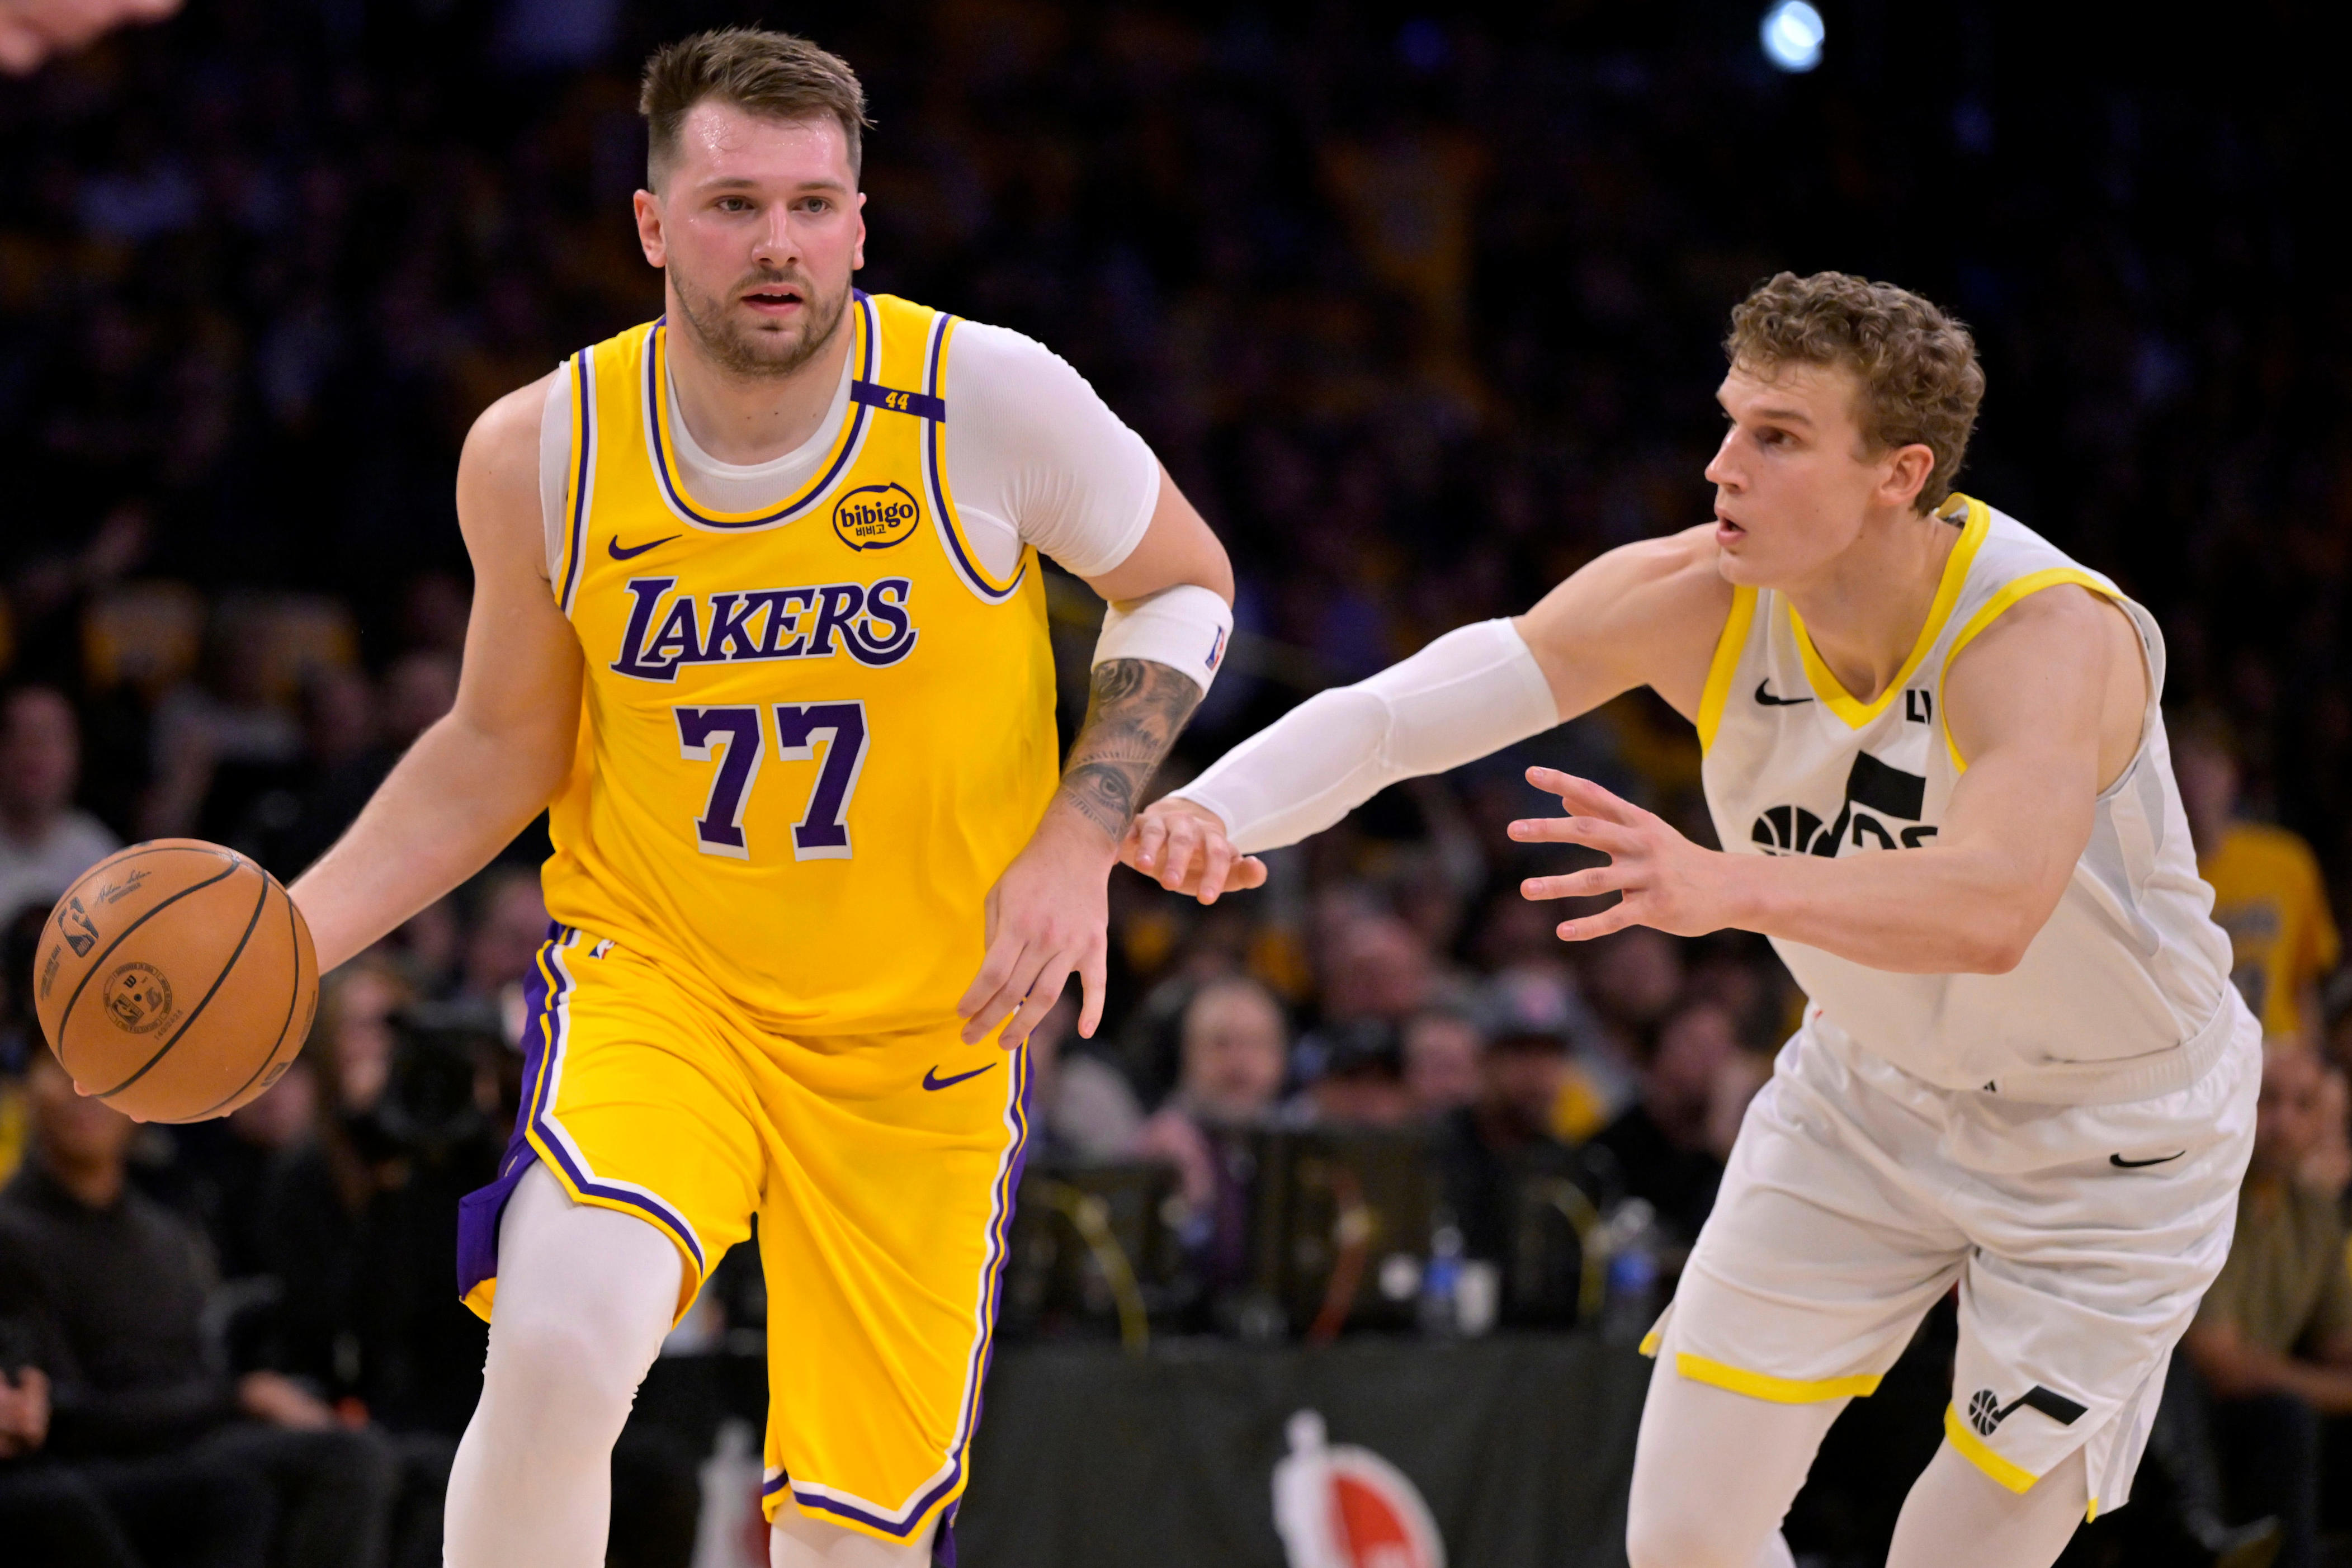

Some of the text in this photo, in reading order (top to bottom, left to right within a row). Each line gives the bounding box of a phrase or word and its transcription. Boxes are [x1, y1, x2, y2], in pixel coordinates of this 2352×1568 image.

[885, 391, 910, 410] 44
[840, 502, 914, 527] bibigo
[856, 524, 886, 536] 비비고
[609, 575, 920, 684] LAKERS
[671, 699, 871, 862] 77
